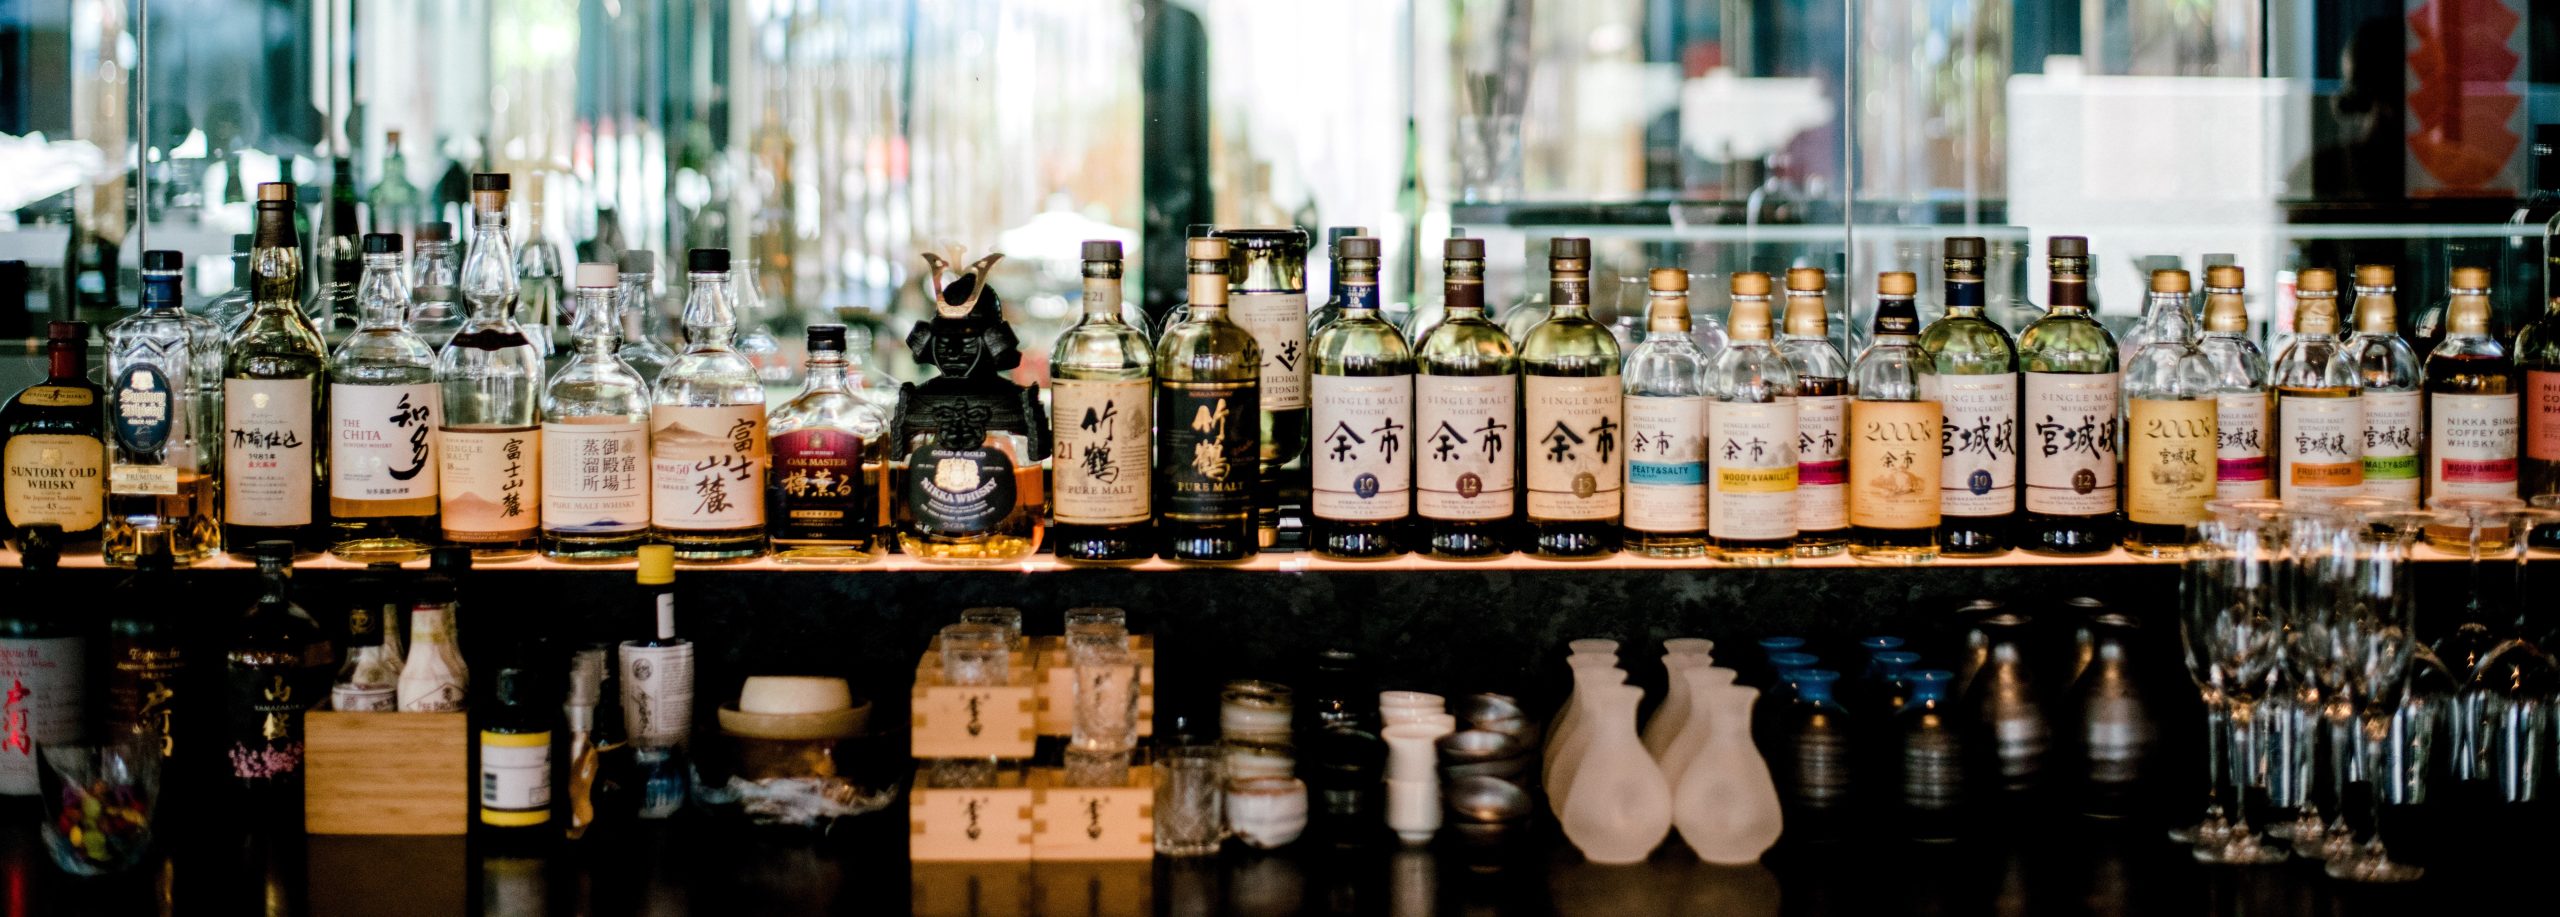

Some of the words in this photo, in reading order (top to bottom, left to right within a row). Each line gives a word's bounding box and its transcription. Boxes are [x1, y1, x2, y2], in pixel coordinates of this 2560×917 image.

[1324, 395, 1372, 406] SINGLE
[1376, 395, 1404, 405] MALT
[1427, 395, 1474, 406] SINGLE
[1479, 395, 1509, 405] MALT
[1541, 396, 1589, 406] SINGLE
[1593, 395, 1619, 405] MALT
[2041, 393, 2090, 403] SINGLE
[342, 419, 360, 428] THE
[2447, 417, 2487, 426] NIKKA
[230, 427, 303, 449] 木桶仕込
[343, 430, 382, 441] CHITA
[389, 392, 430, 481] 知多
[2447, 428, 2494, 438] COFFEY
[1080, 399, 1120, 484] 竹鶴
[1191, 398, 1231, 481] 竹鶴
[1324, 417, 1404, 464] 余市
[1427, 417, 1507, 464] 余市
[1541, 416, 1618, 464] 余市
[1631, 430, 1674, 456] 余市
[2447, 439, 2496, 449] WHISKY
[931, 449, 954, 457] GOLD
[1058, 441, 1073, 460] 21
[1721, 437, 1768, 462] 余市
[602, 438, 620, 492] 御殿場
[787, 458, 807, 466] OAK
[808, 458, 848, 466] MASTER
[1880, 450, 1916, 469] 余市
[11, 466, 66, 478] SUNTORY
[69, 467, 97, 478] OLD
[621, 455, 636, 491] 富士
[1632, 465, 1689, 475] PEATY&SALTY
[500, 437, 525, 518] 富士山麓
[1973, 475, 1988, 487] 10
[2077, 474, 2092, 486] 12
[28, 480, 76, 490] WHISKY
[921, 476, 955, 503] NIKKA
[955, 476, 998, 503] WHISKY
[1068, 485, 1098, 494] PURE
[1102, 485, 1134, 494] MALT
[1178, 481, 1209, 492] PURE
[1213, 481, 1245, 492] MALT
[1359, 478, 1374, 490] 10
[1462, 478, 1477, 490] 12
